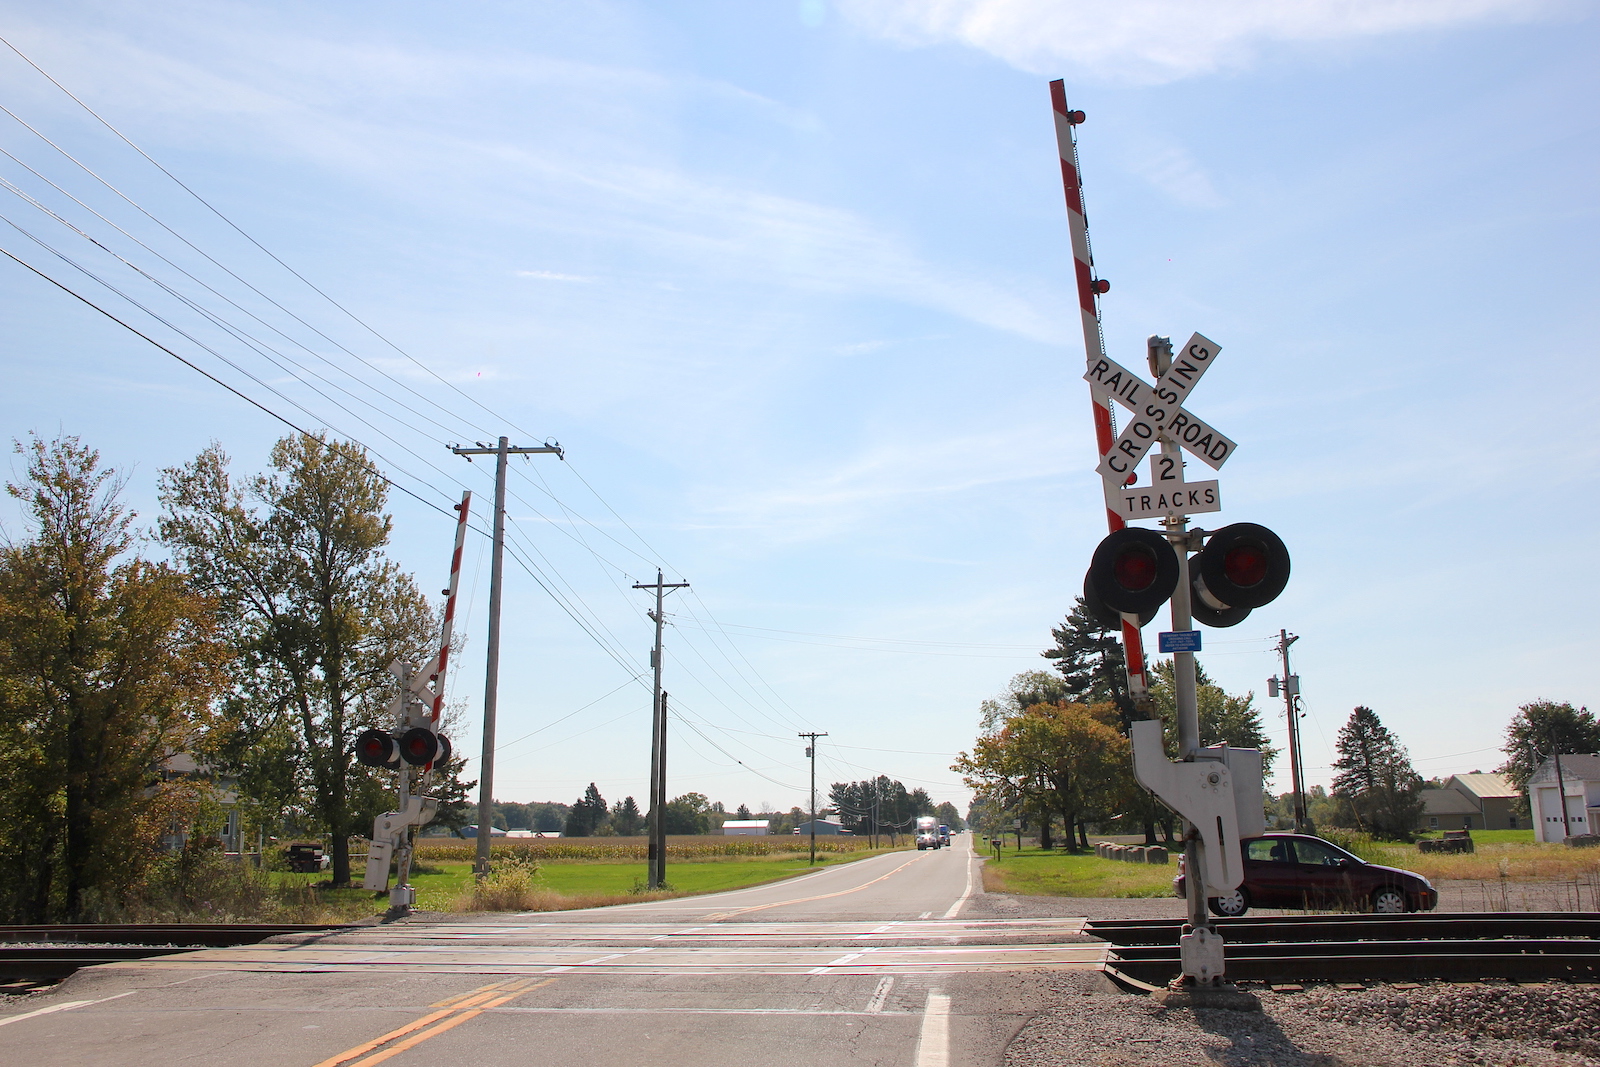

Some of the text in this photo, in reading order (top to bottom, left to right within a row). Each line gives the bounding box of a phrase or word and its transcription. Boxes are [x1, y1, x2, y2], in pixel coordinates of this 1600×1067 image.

[1090, 359, 1228, 461] RAIL ROAD
[1108, 344, 1209, 473] CROSSING
[1126, 488, 1215, 512] TRACKS
[1159, 458, 1175, 480] 2
